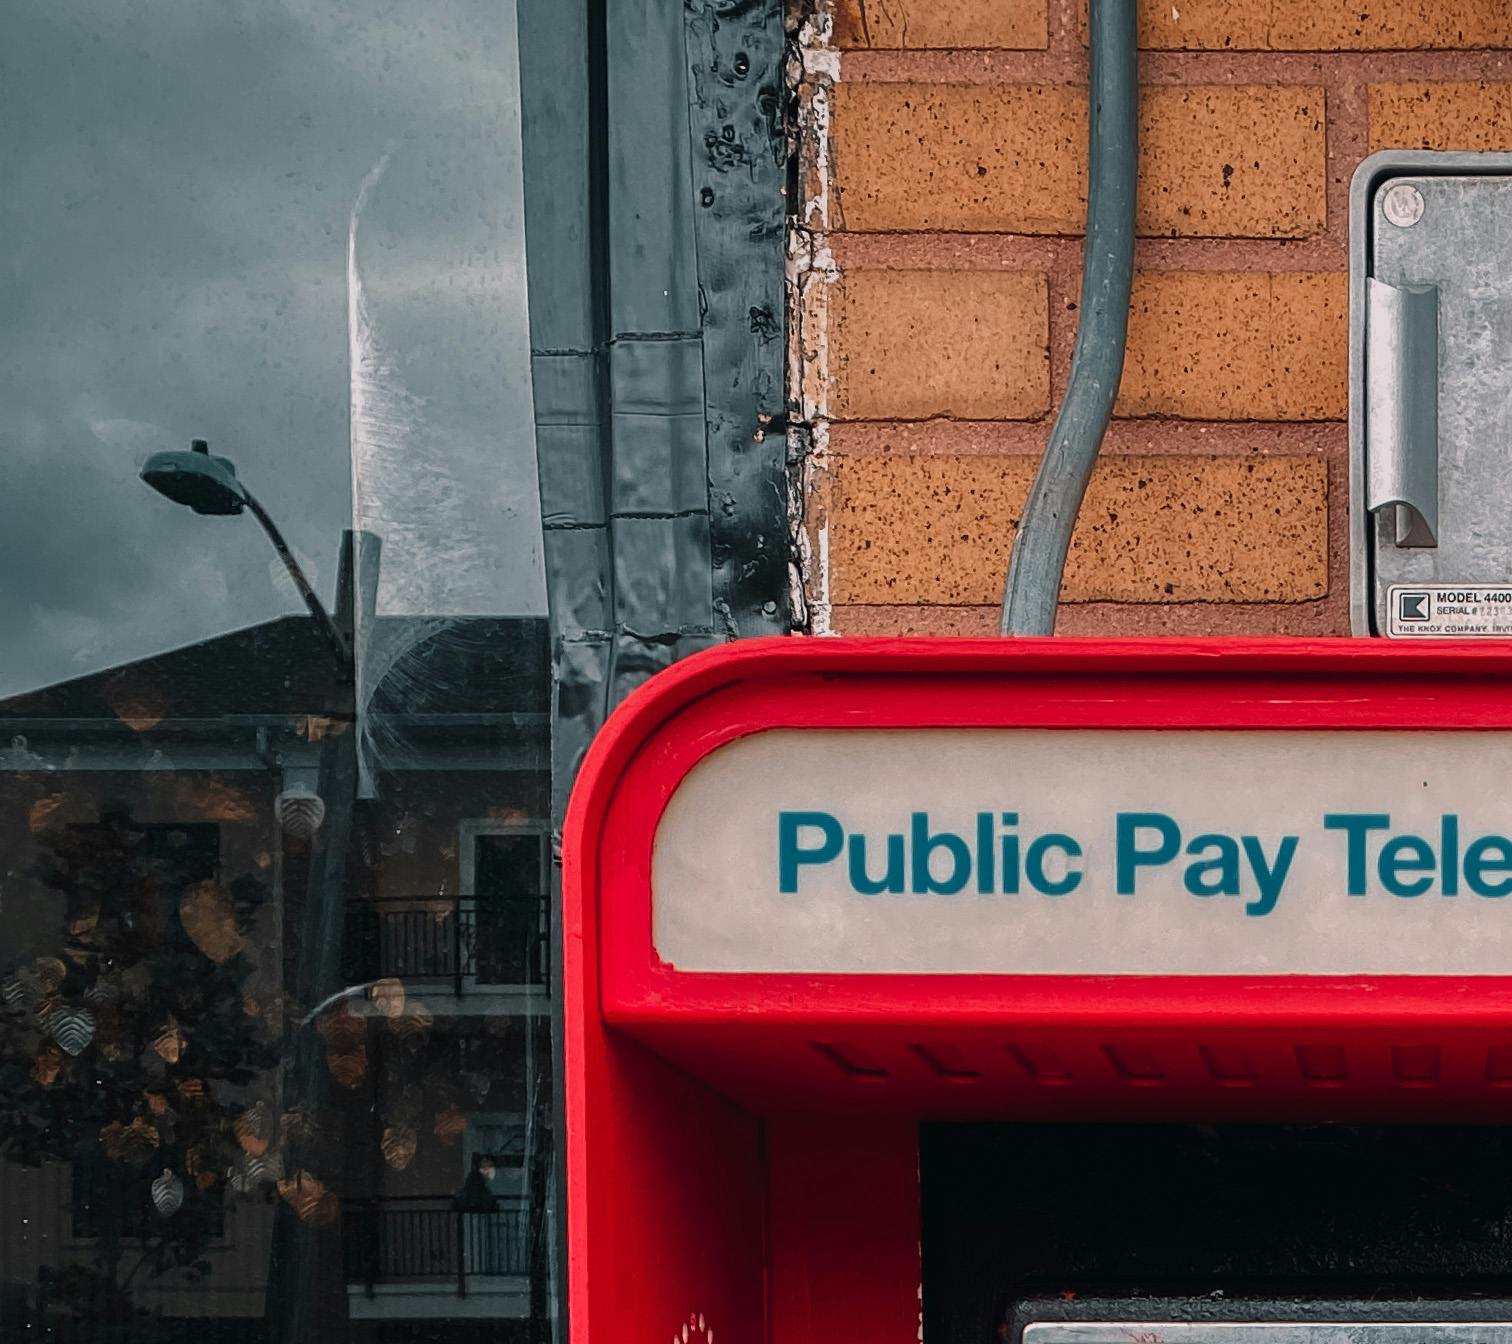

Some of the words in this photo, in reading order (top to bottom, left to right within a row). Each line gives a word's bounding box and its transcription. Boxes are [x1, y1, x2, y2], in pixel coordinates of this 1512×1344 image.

[1436, 592, 1482, 603] MODEL
[1436, 606, 1470, 615] SERIAL
[1398, 625, 1415, 633] THE
[1418, 625, 1442, 633] KNOX
[777, 811, 1083, 896] Public
[1116, 811, 1300, 918] Pay
